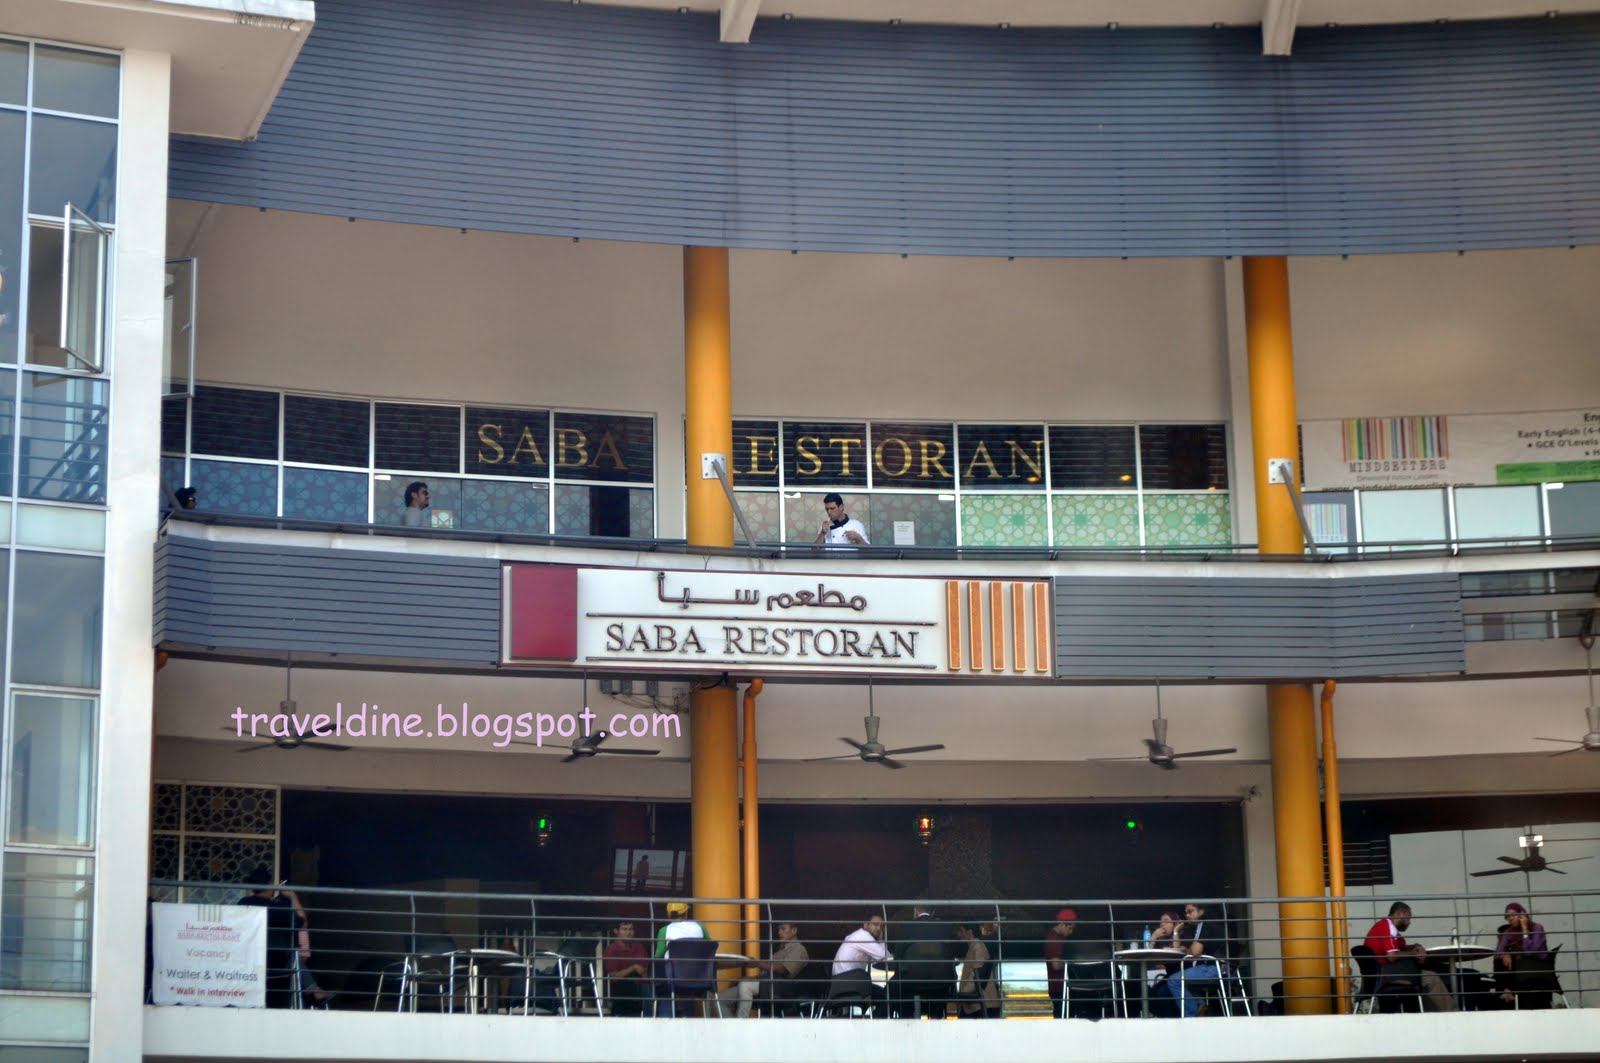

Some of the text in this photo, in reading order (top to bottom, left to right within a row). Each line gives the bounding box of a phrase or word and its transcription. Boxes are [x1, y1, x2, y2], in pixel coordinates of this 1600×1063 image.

[1517, 430, 1542, 439] Early
[1544, 427, 1581, 437] English
[478, 423, 1045, 480] SABA ESTORAN
[1350, 459, 1446, 473] MINDSETTERS
[766, 584, 867, 611] مطعم
[606, 622, 918, 658] SABA RESTORAN
[186, 947, 231, 960] Vacancy
[166, 969, 258, 981] Waiter & Waitress
[176, 987, 194, 995] Walk
